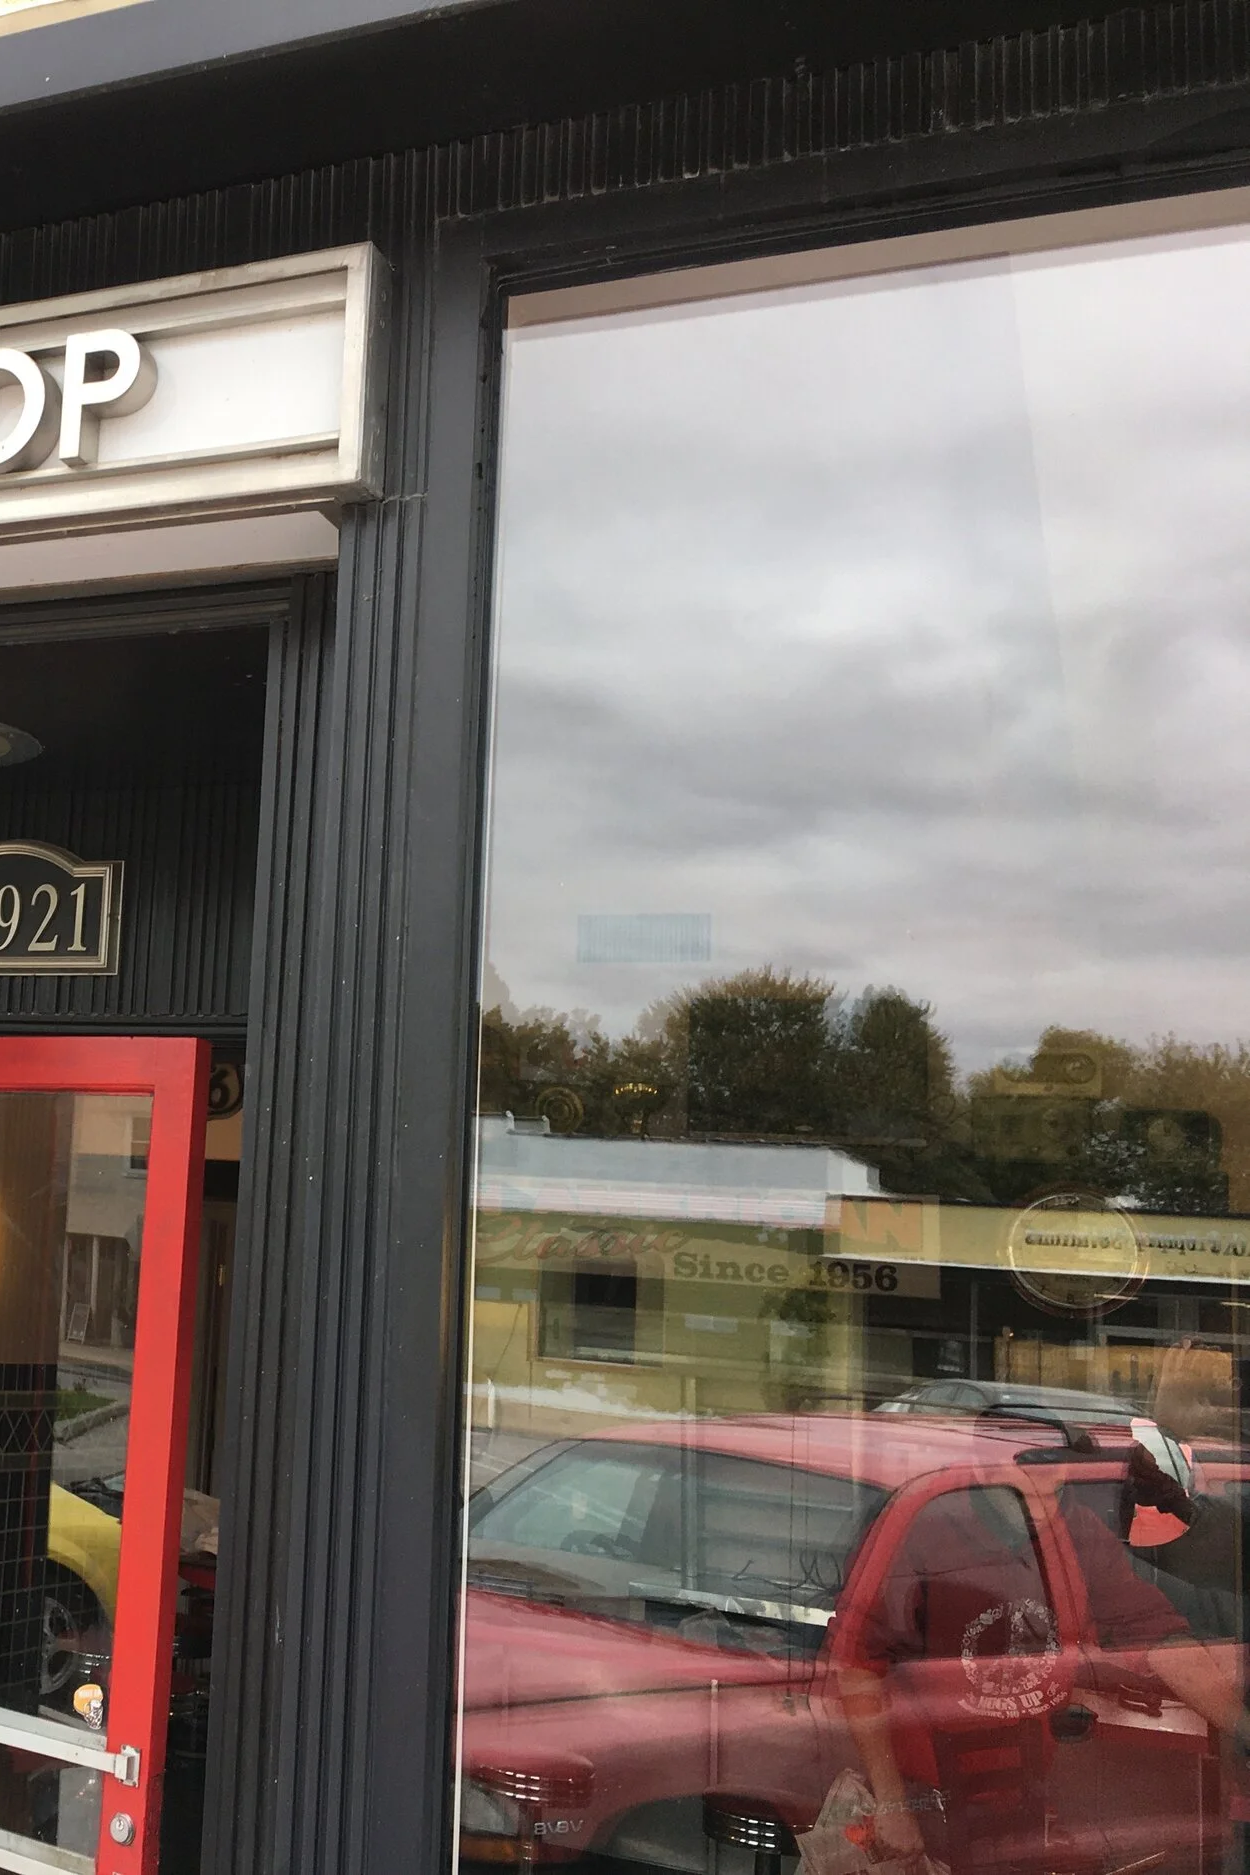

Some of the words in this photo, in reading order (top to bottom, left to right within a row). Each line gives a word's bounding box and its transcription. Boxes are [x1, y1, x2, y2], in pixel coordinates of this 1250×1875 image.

[674, 1251, 790, 1285] Since
[808, 1259, 898, 1293] 1956
[1019, 1690, 1044, 1709] UP
